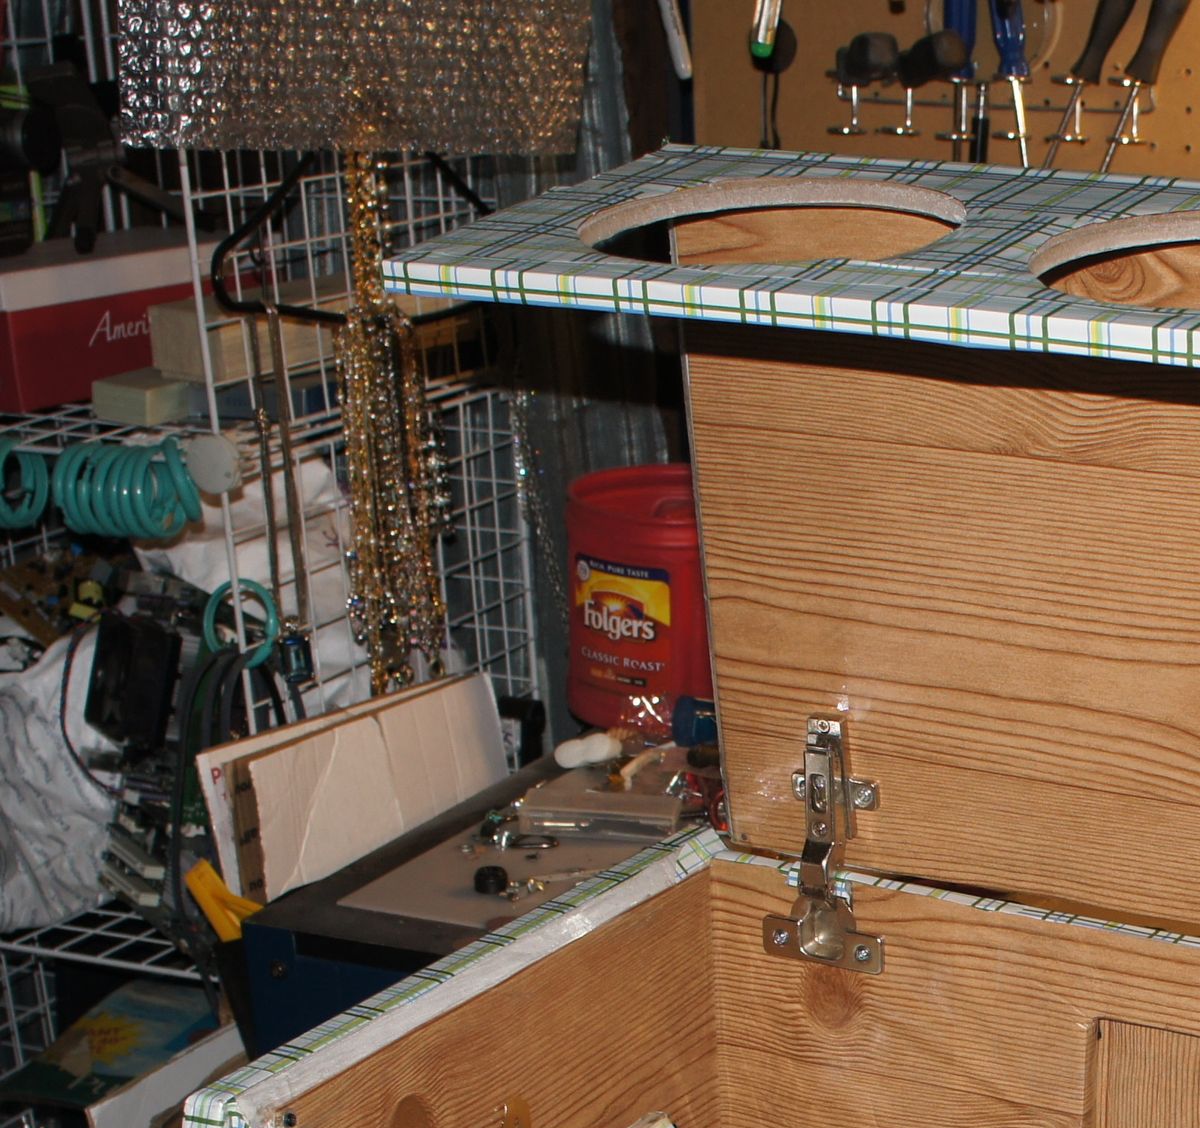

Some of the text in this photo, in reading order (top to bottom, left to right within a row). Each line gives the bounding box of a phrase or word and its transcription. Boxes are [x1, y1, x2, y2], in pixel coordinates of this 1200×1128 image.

[88, 309, 152, 348] Ameri
[627, 568, 649, 579] TASTE
[584, 600, 655, 641] Folgers
[580, 645, 662, 673] CLASSIC ROAST
